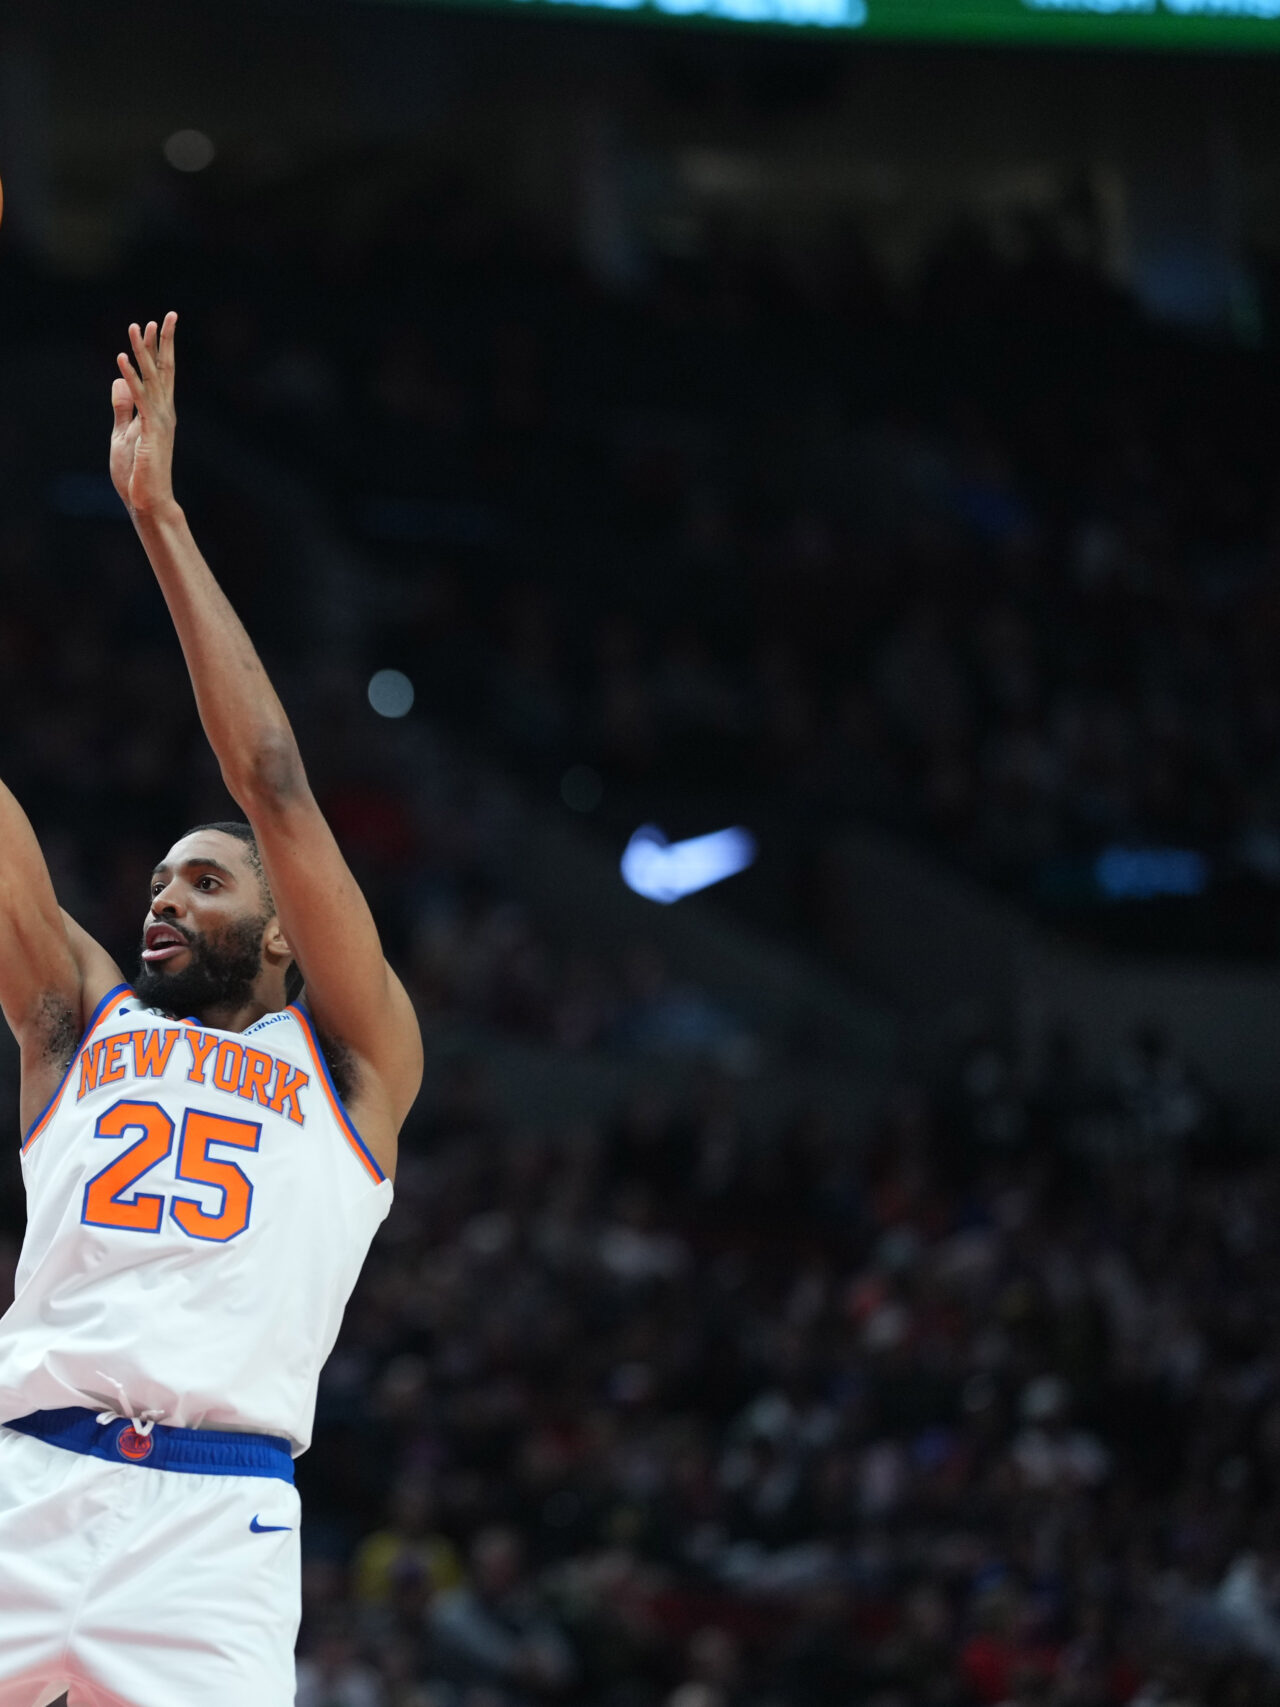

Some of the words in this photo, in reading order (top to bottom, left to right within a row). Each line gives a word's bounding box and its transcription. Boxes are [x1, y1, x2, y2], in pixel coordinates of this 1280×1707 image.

[76, 1028, 181, 1103] NEW
[184, 1028, 309, 1127] YORK
[80, 1099, 263, 1243] 25
